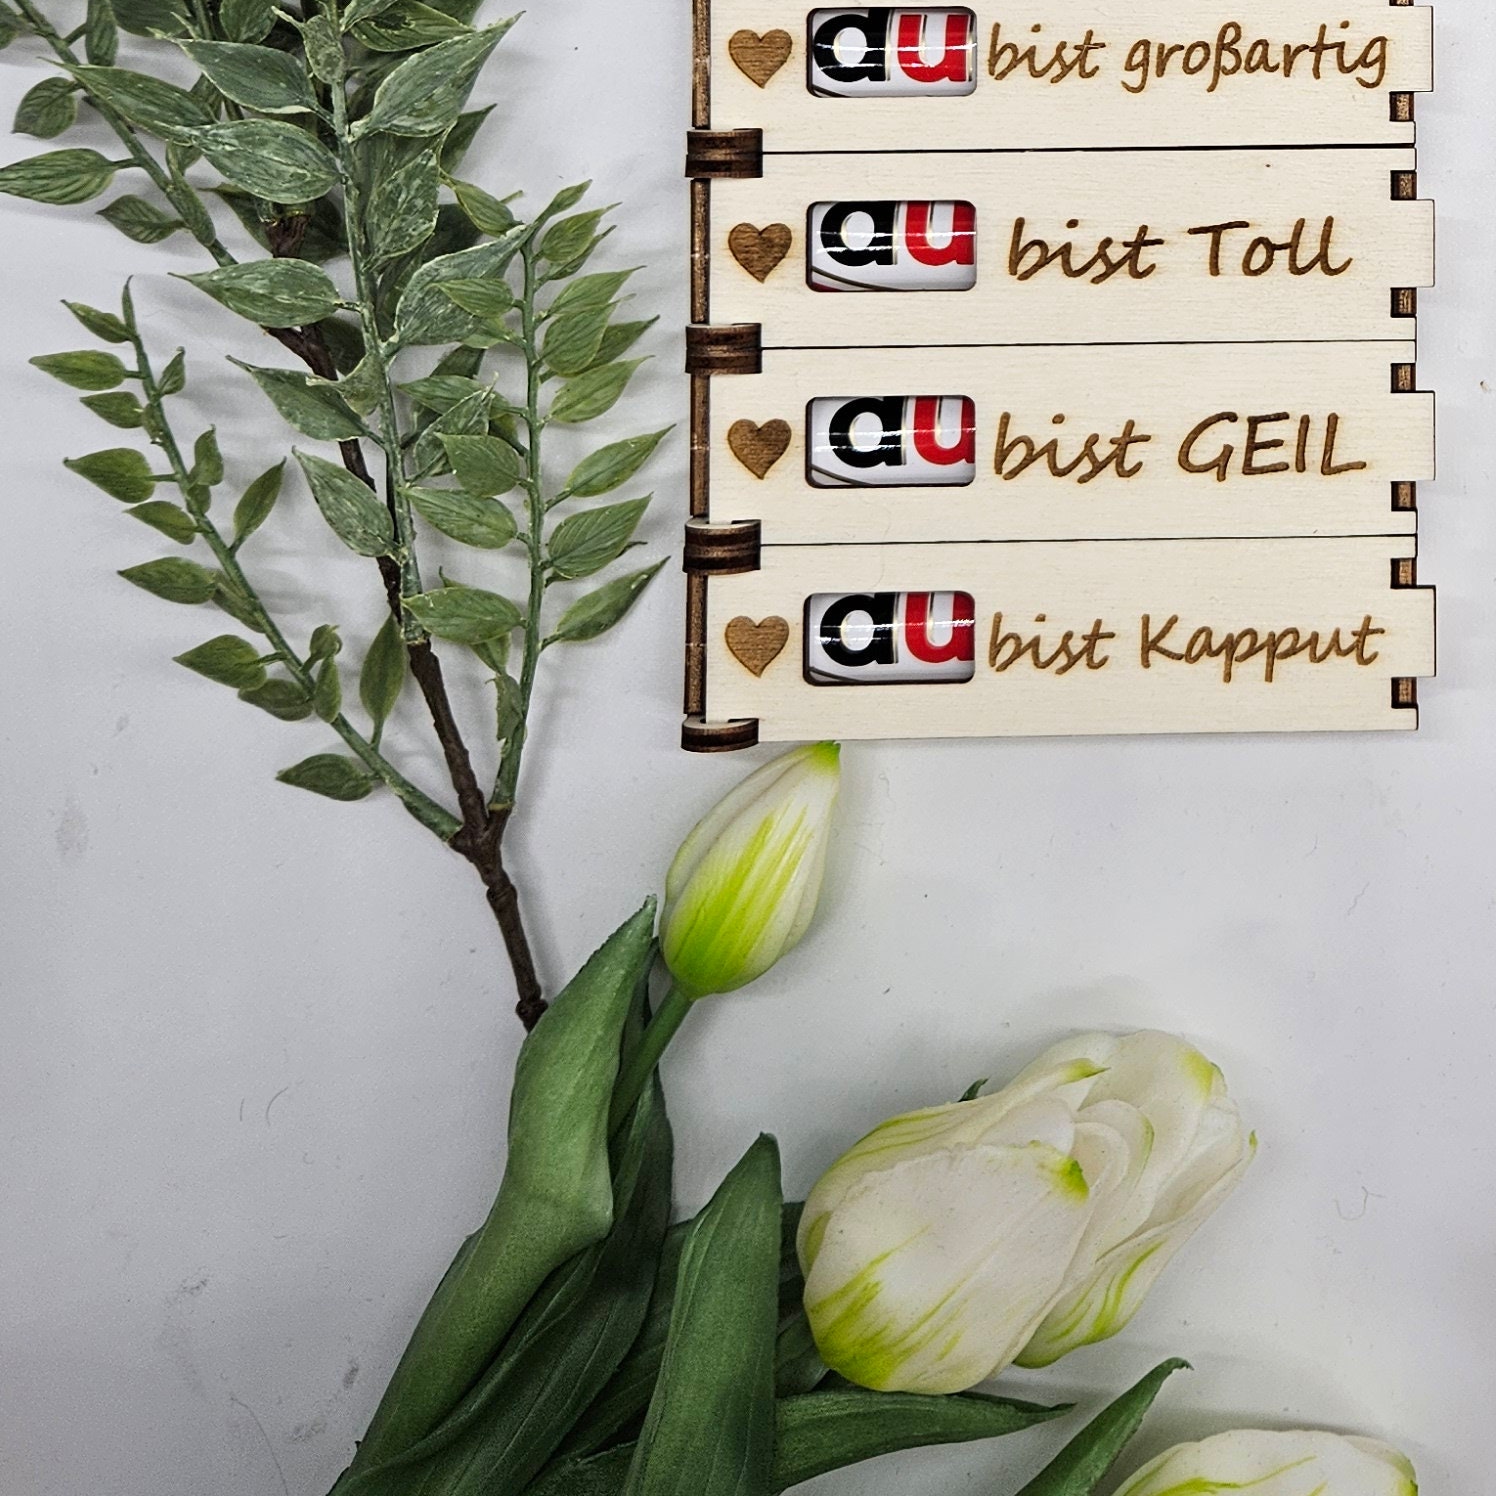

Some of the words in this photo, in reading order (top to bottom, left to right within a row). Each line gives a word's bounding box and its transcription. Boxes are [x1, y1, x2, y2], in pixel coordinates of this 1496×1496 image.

[812, 9, 975, 83] du
[986, 21, 1107, 85] bist
[1120, 20, 1389, 92] großartig
[1006, 216, 1168, 286] bist
[1187, 216, 1353, 278] Toll
[992, 411, 1153, 485] bist
[1177, 411, 1368, 483] GEIL
[987, 611, 1117, 677] bist
[1139, 613, 1387, 685] Kapput
